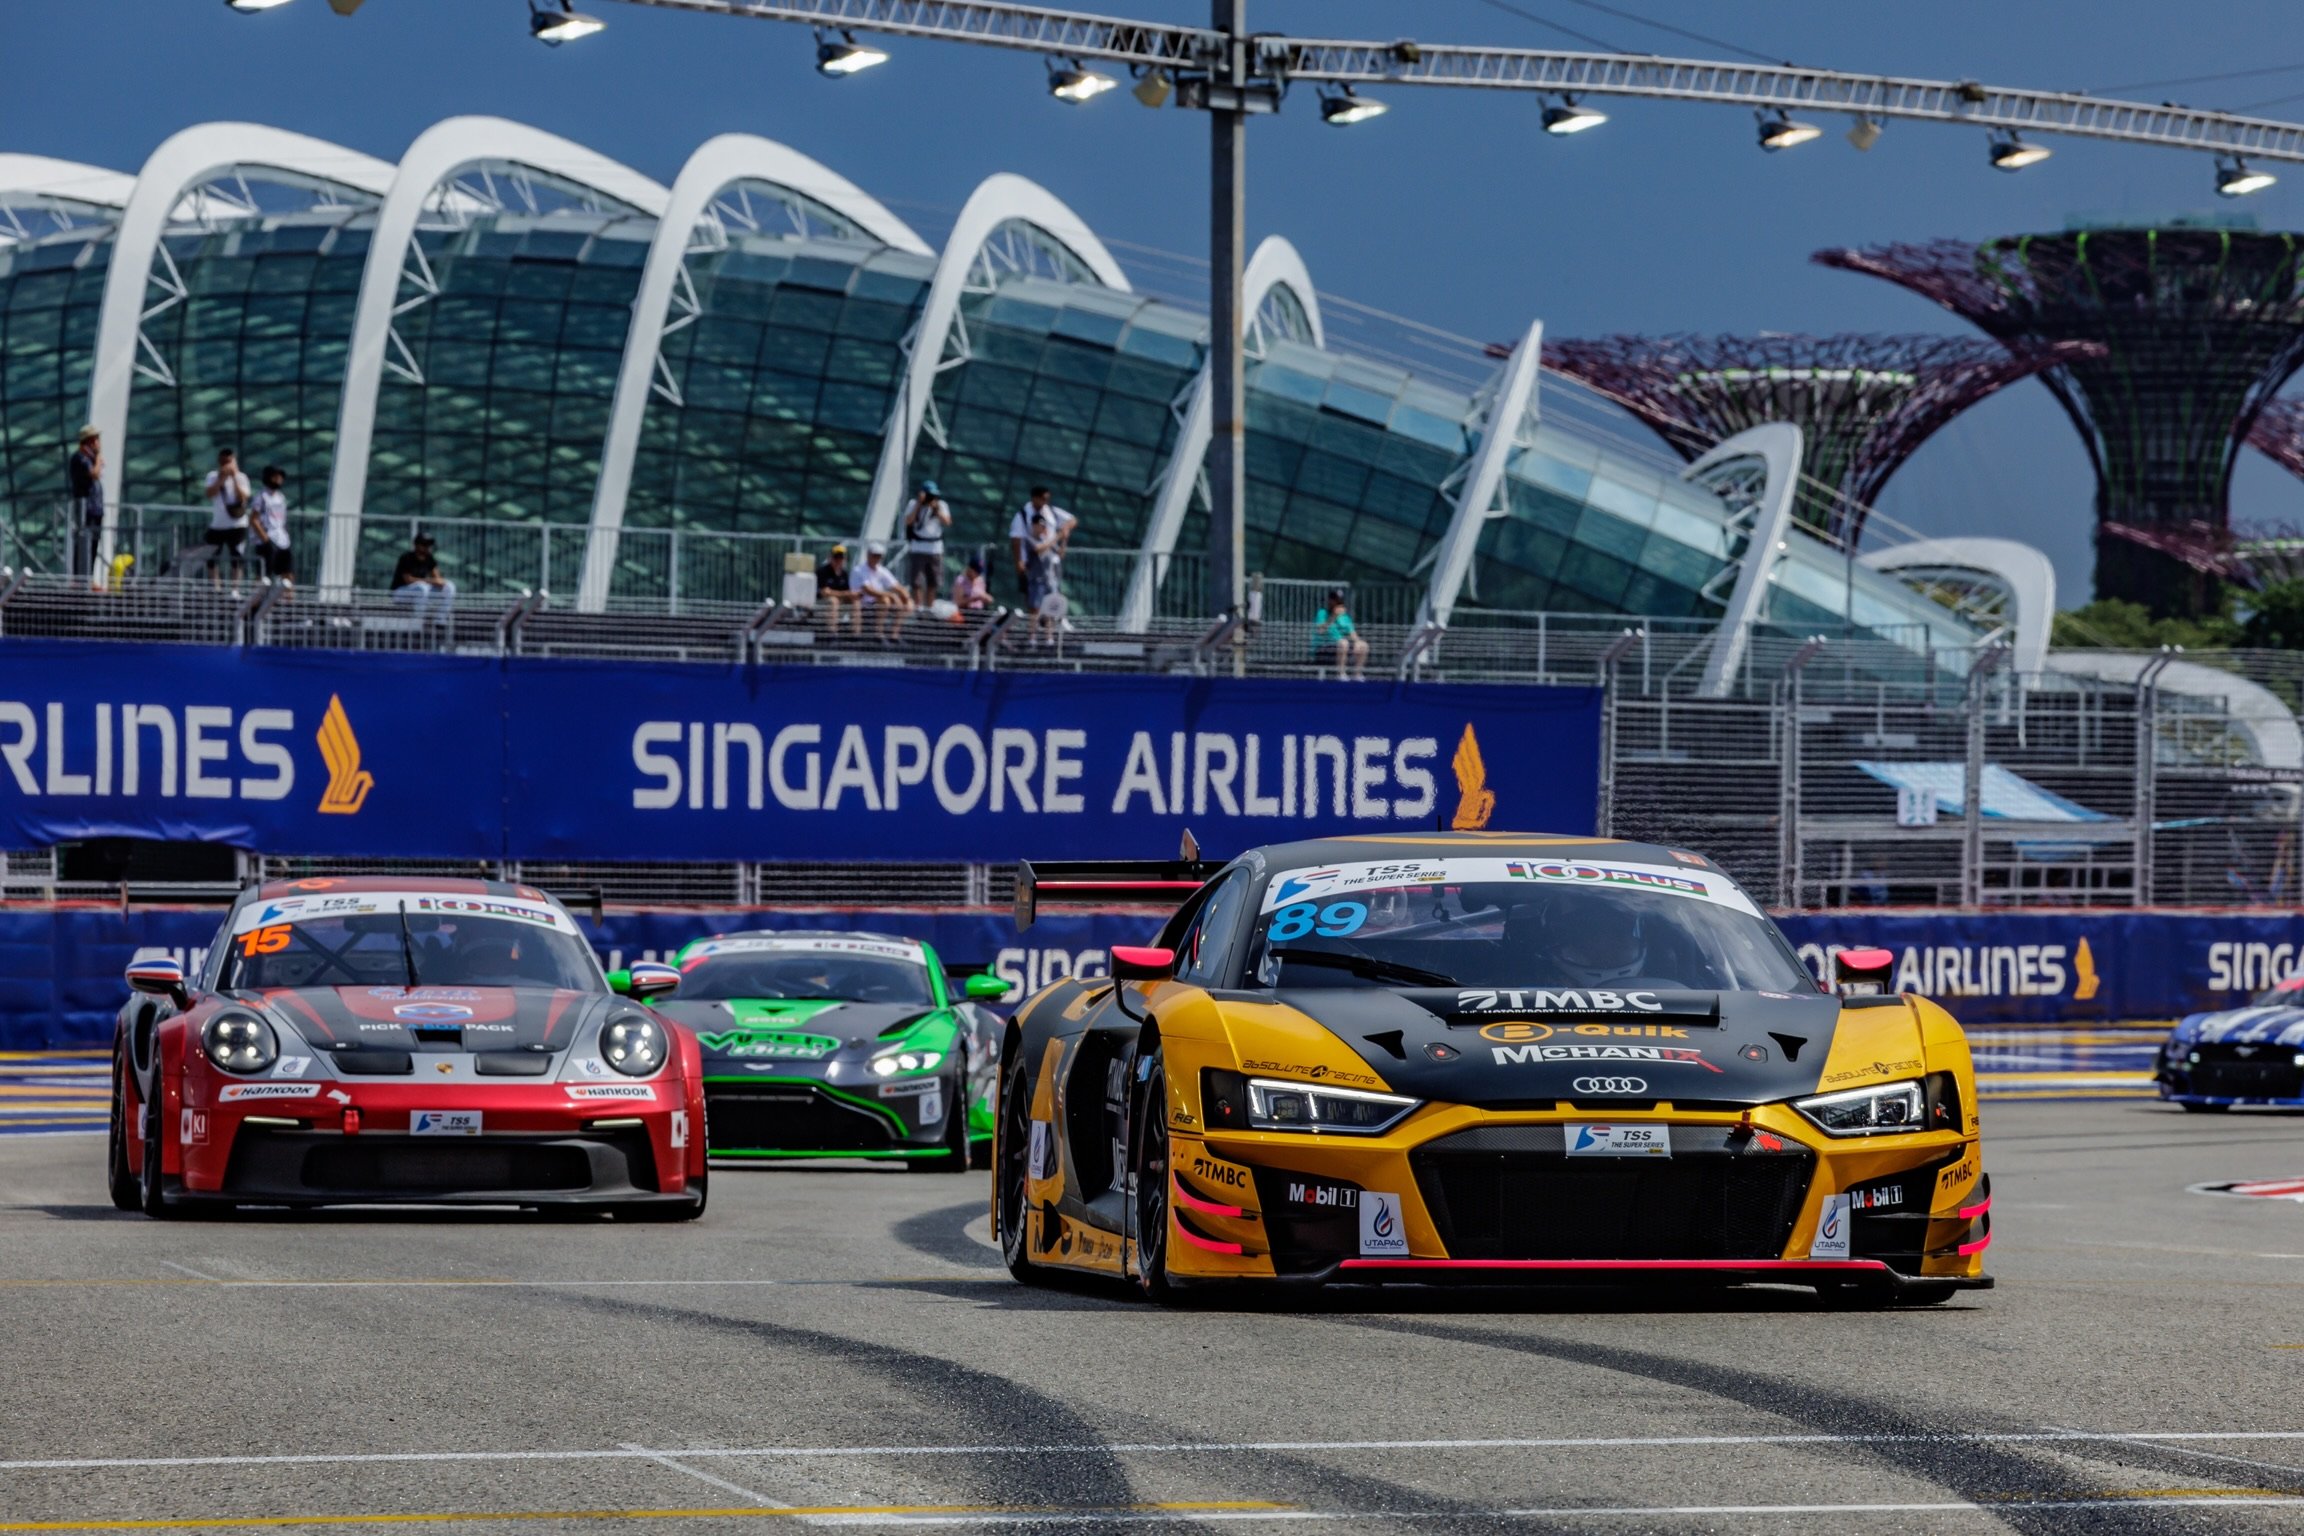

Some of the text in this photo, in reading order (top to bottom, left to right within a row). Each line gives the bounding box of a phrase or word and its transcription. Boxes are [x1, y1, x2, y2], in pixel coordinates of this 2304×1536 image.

[632, 722, 1438, 819] SINGAPORE AIRLINES
[1344, 878, 1364, 886] THE
[1366, 873, 1404, 883] SUPER
[1406, 871, 1446, 879] SERIES
[1366, 864, 1421, 875] TSS
[1612, 872, 1695, 890] PLUS
[322, 897, 360, 906] TSS
[1267, 901, 1368, 942] 89
[238, 924, 292, 956] 15
[996, 948, 1106, 1003] SING
[1895, 945, 2066, 995] AIRLINES
[2209, 942, 2304, 990] SING
[1498, 990, 1663, 1010] TMBC
[359, 1023, 401, 1031] PICK
[465, 1023, 514, 1032] PACK
[450, 1117, 470, 1125] TSS
[1623, 1131, 1652, 1141] TSS
[1204, 1161, 1247, 1189] TMBC
[1947, 1160, 1973, 1187] TMBC
[1289, 1183, 1337, 1205] Mobil
[1852, 1186, 1889, 1210] Mobil
[1365, 1239, 1405, 1247] UTAPAO
[1814, 1241, 1846, 1249] UTAPAO
